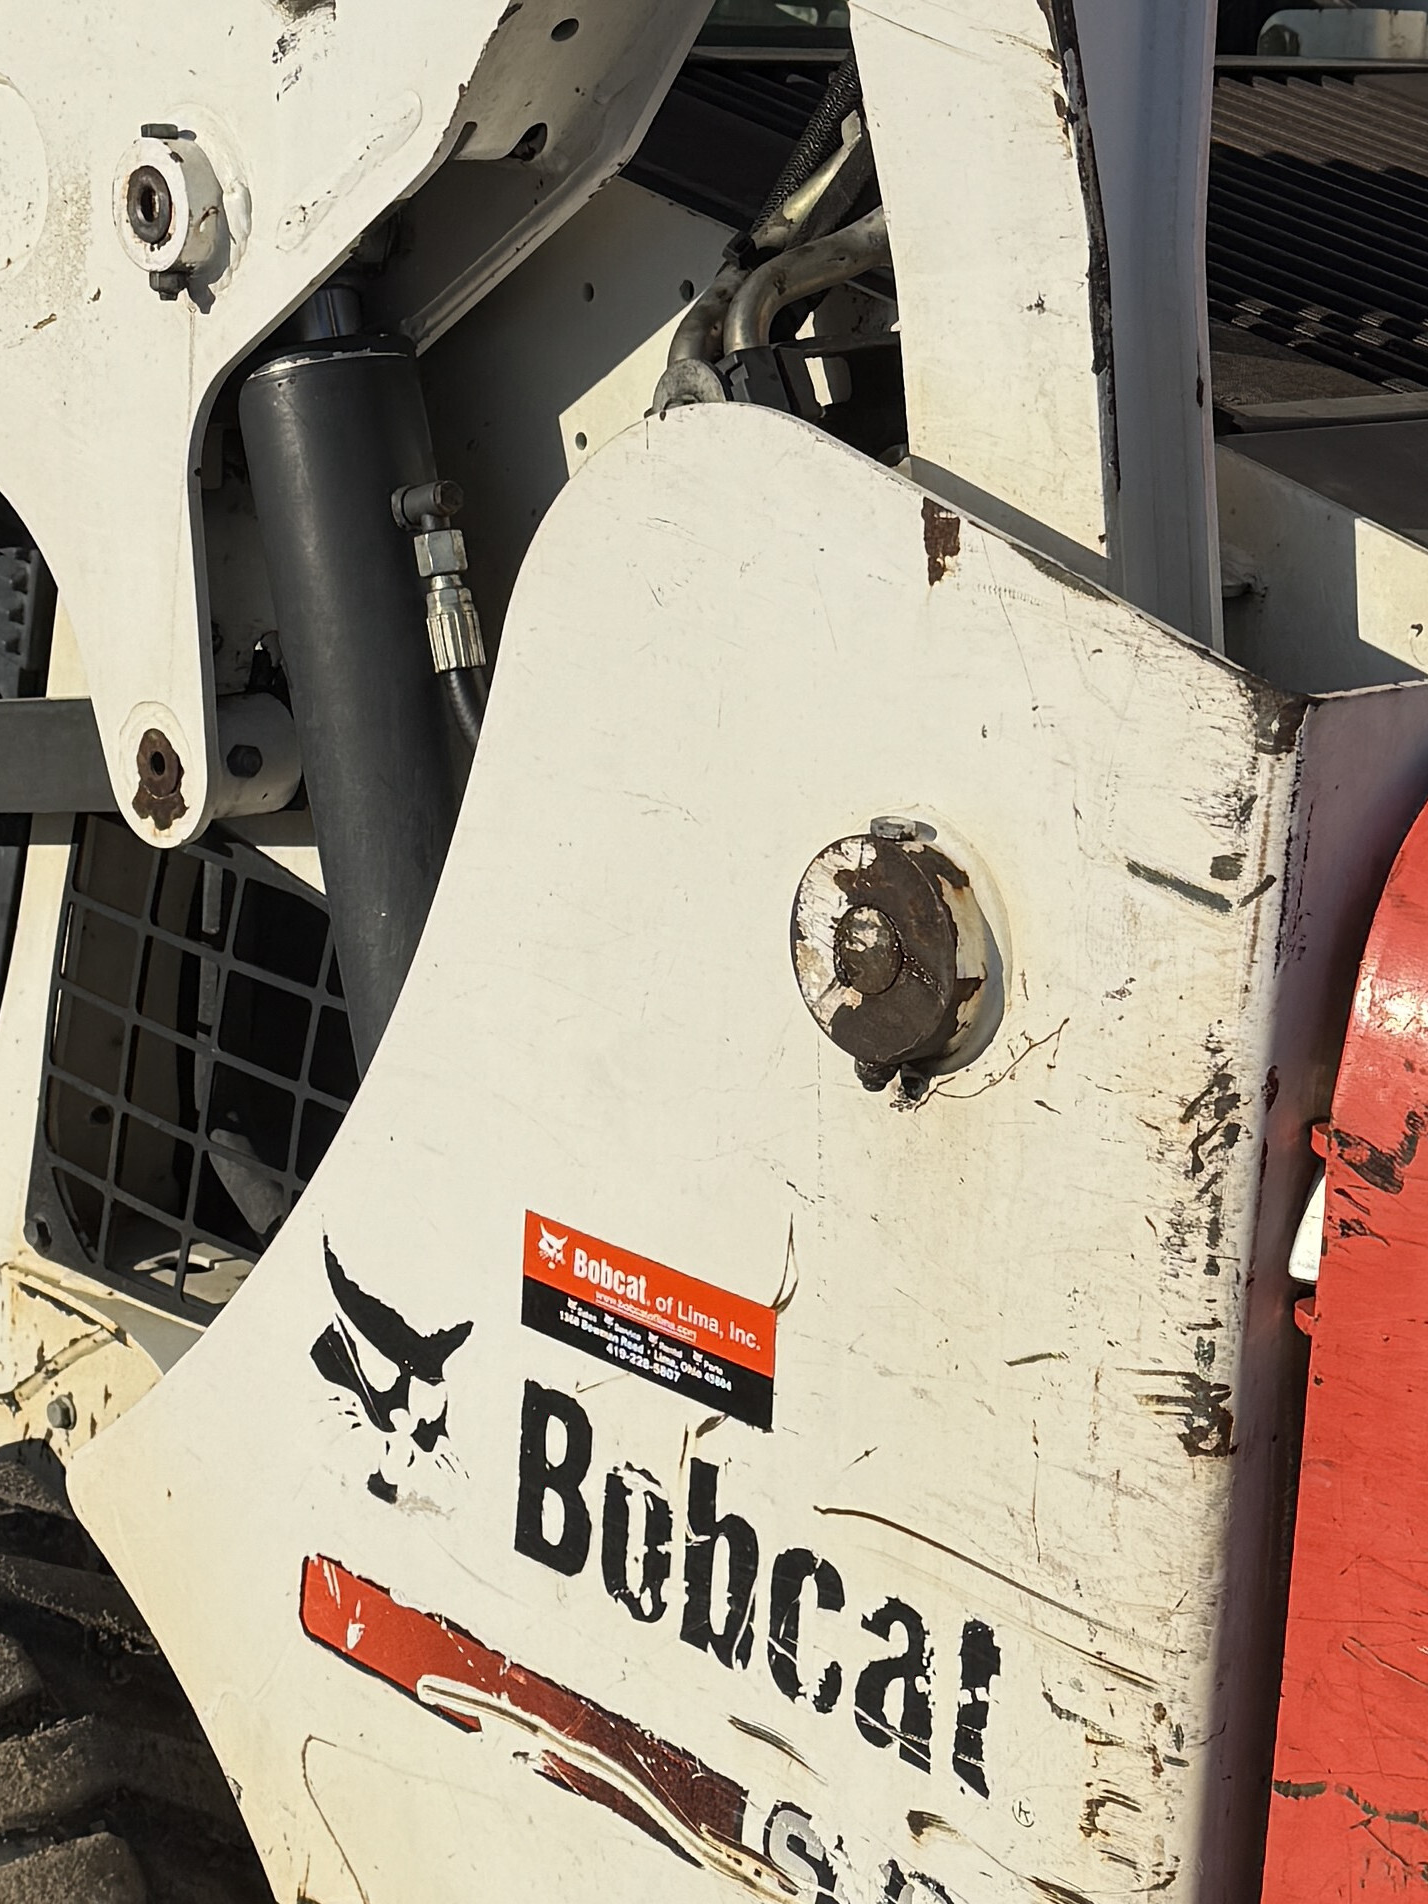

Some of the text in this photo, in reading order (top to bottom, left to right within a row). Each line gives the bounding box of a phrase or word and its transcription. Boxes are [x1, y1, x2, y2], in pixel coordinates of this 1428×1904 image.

[655, 1296, 674, 1315] of
[677, 1300, 724, 1340] Lima,
[729, 1320, 761, 1352] Inc.
[605, 1343, 682, 1384] 419-228-5807
[513, 1379, 1002, 1800] Bobcat
